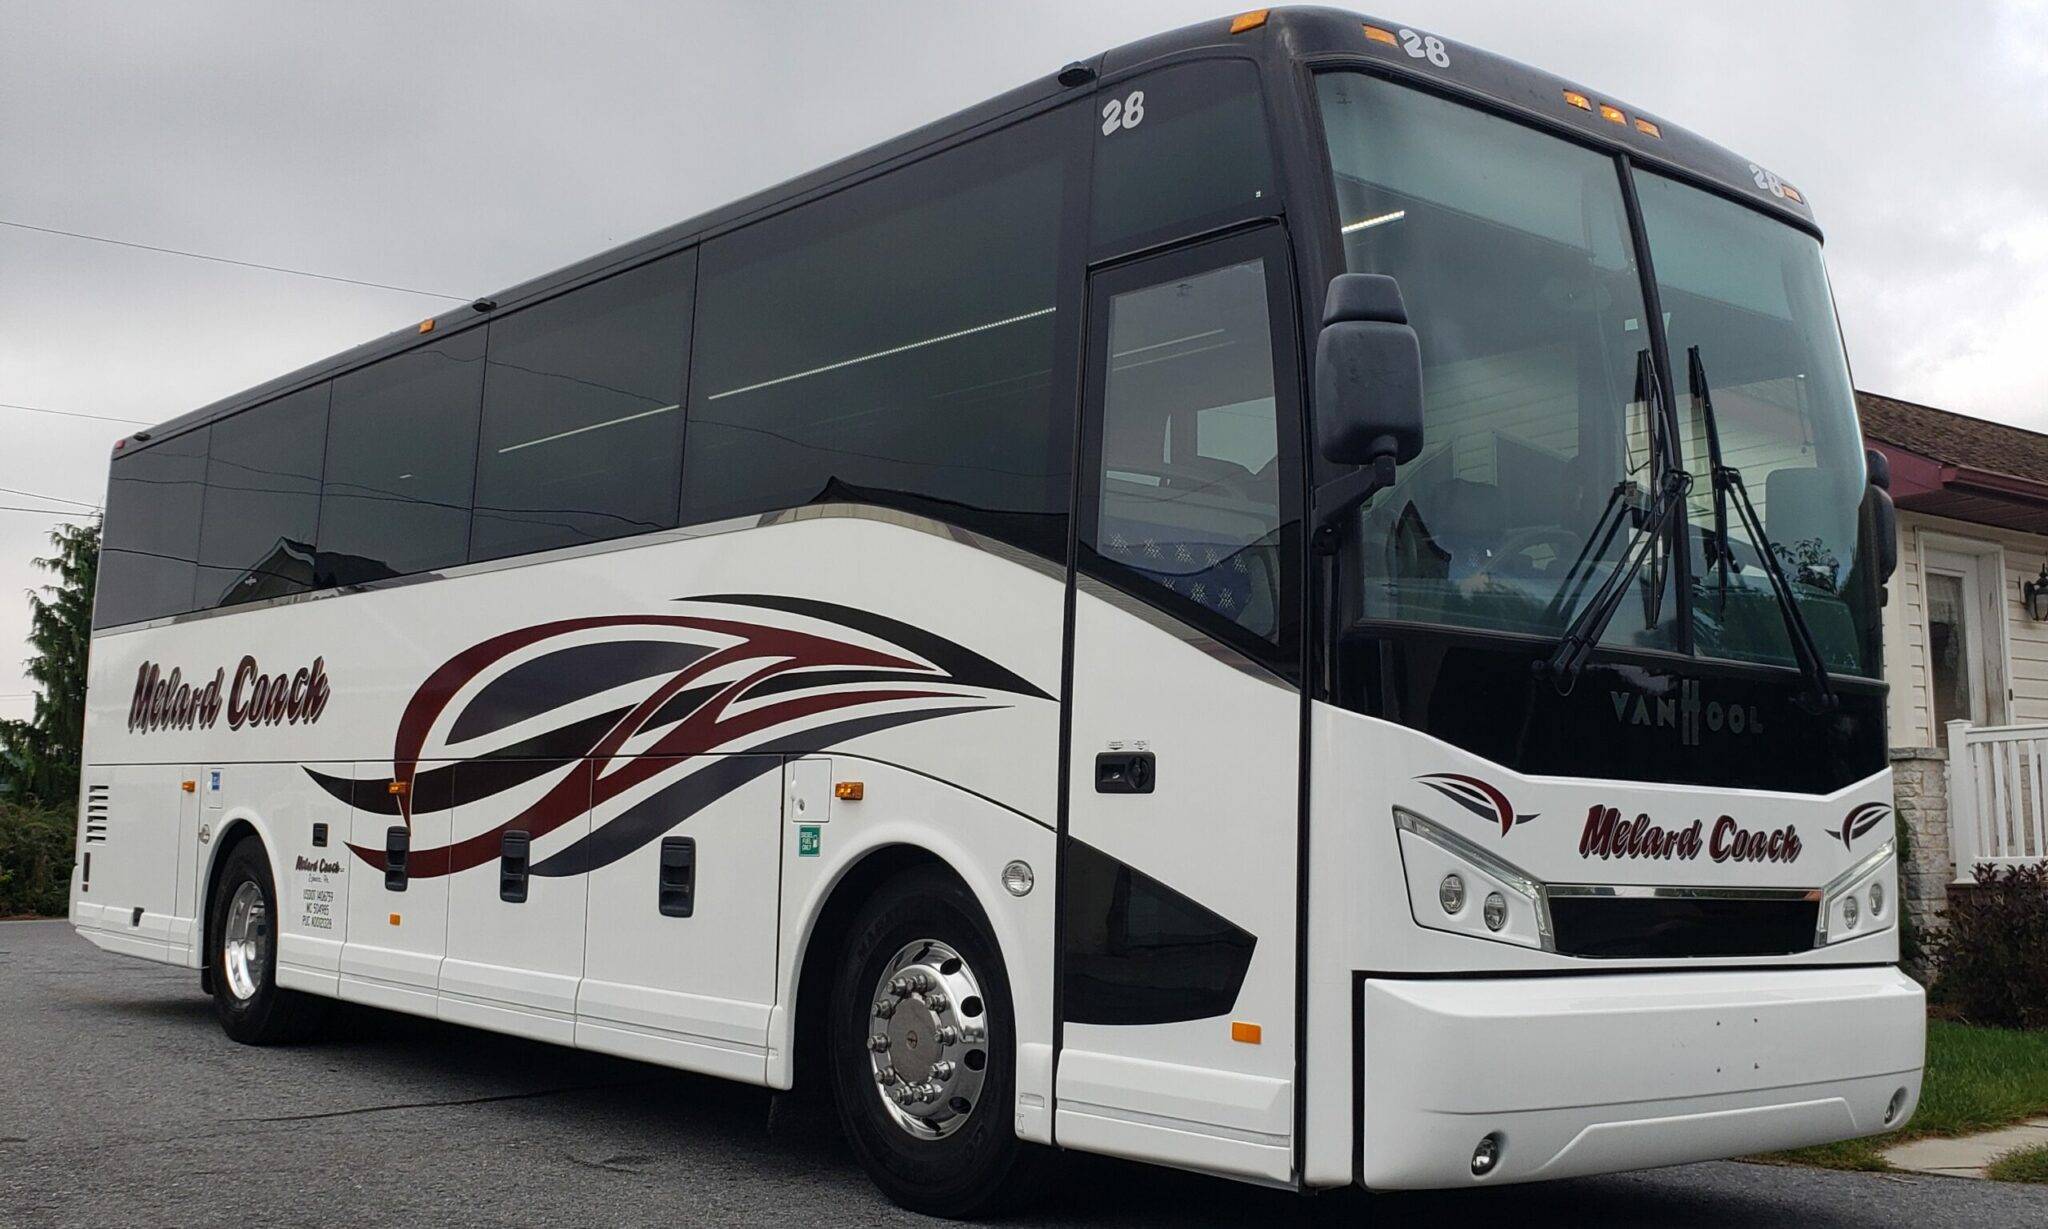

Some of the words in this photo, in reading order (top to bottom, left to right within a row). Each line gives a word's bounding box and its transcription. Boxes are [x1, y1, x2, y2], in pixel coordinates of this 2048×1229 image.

[1399, 29, 1450, 68] 28
[1102, 91, 1144, 136] 28
[1748, 164, 1785, 198] 28
[128, 660, 225, 735] Melard
[227, 655, 330, 731] Coach
[1579, 804, 1703, 860] Melard
[1708, 815, 1802, 864] Coach
[296, 854, 319, 872] Melard
[319, 858, 340, 873] Coach
